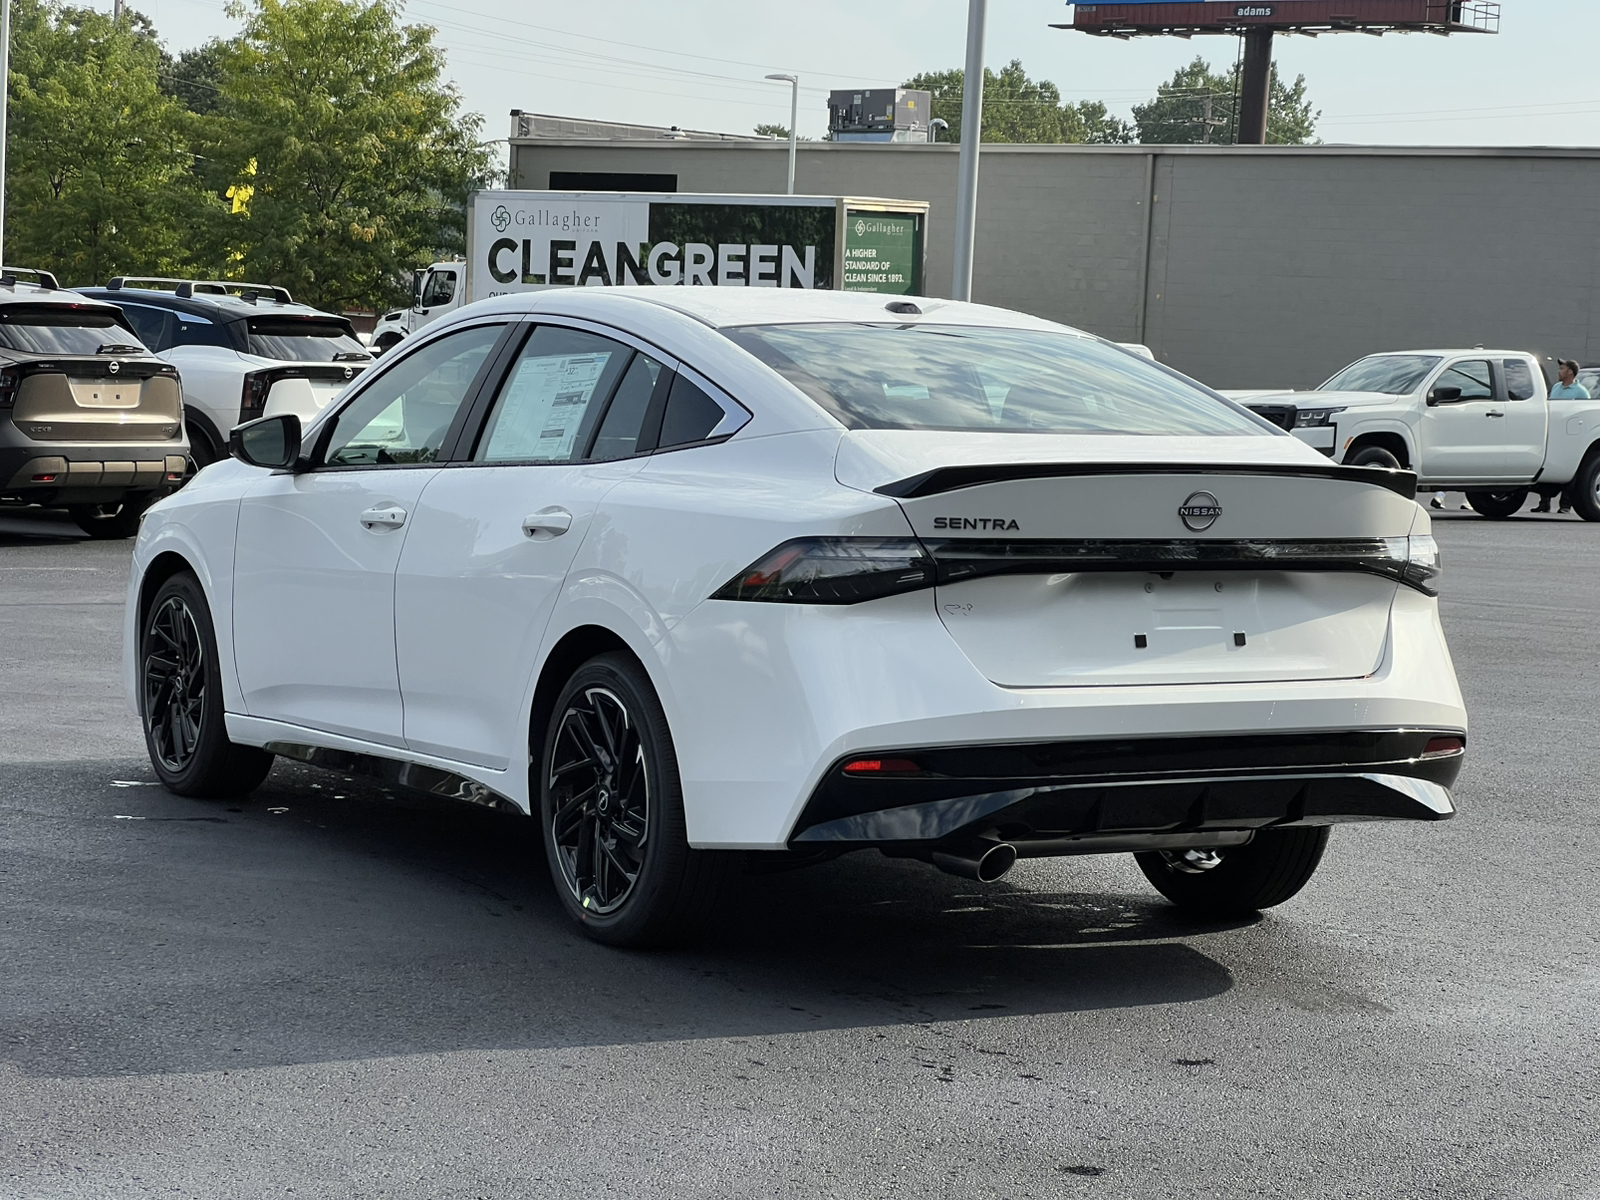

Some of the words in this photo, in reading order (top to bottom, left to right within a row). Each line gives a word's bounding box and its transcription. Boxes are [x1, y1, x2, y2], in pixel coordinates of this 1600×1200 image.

[1237, 6, 1271, 16] adams
[515, 210, 600, 231] Gallagher
[866, 222, 904, 235] Gallagher
[845, 249, 851, 258] A
[852, 249, 877, 258] HIGHER
[845, 261, 880, 270] STANDARD
[881, 261, 891, 270] OF
[844, 273, 867, 282] CLEAN
[867, 273, 887, 282] SINCE
[1180, 507, 1221, 515] NISSAN
[933, 517, 1020, 531] SENTRA
